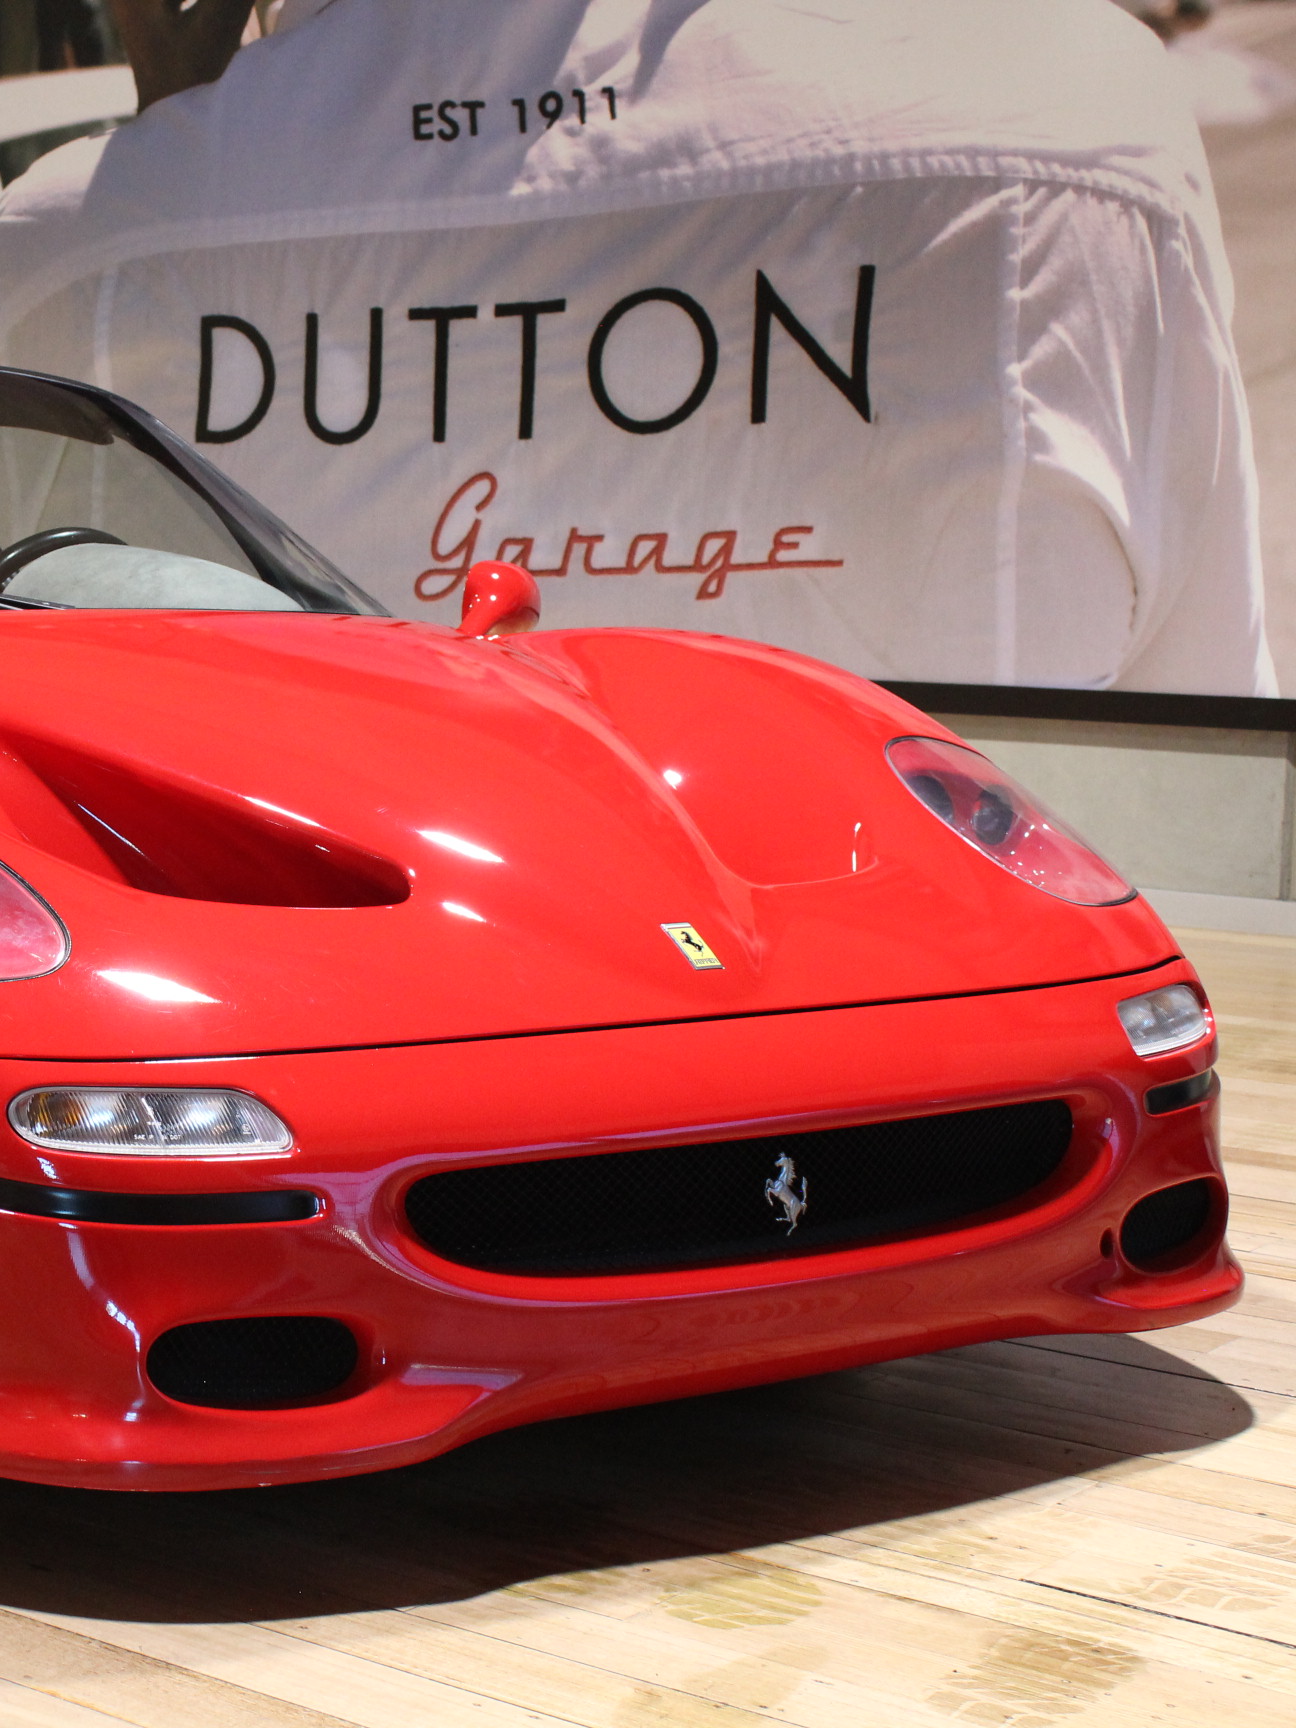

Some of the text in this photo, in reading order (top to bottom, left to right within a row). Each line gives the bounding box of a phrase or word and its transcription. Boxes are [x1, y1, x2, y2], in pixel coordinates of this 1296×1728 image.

[412, 86, 616, 141] EST 1911
[195, 264, 876, 446] DUTTON
[413, 471, 844, 602] Garage
